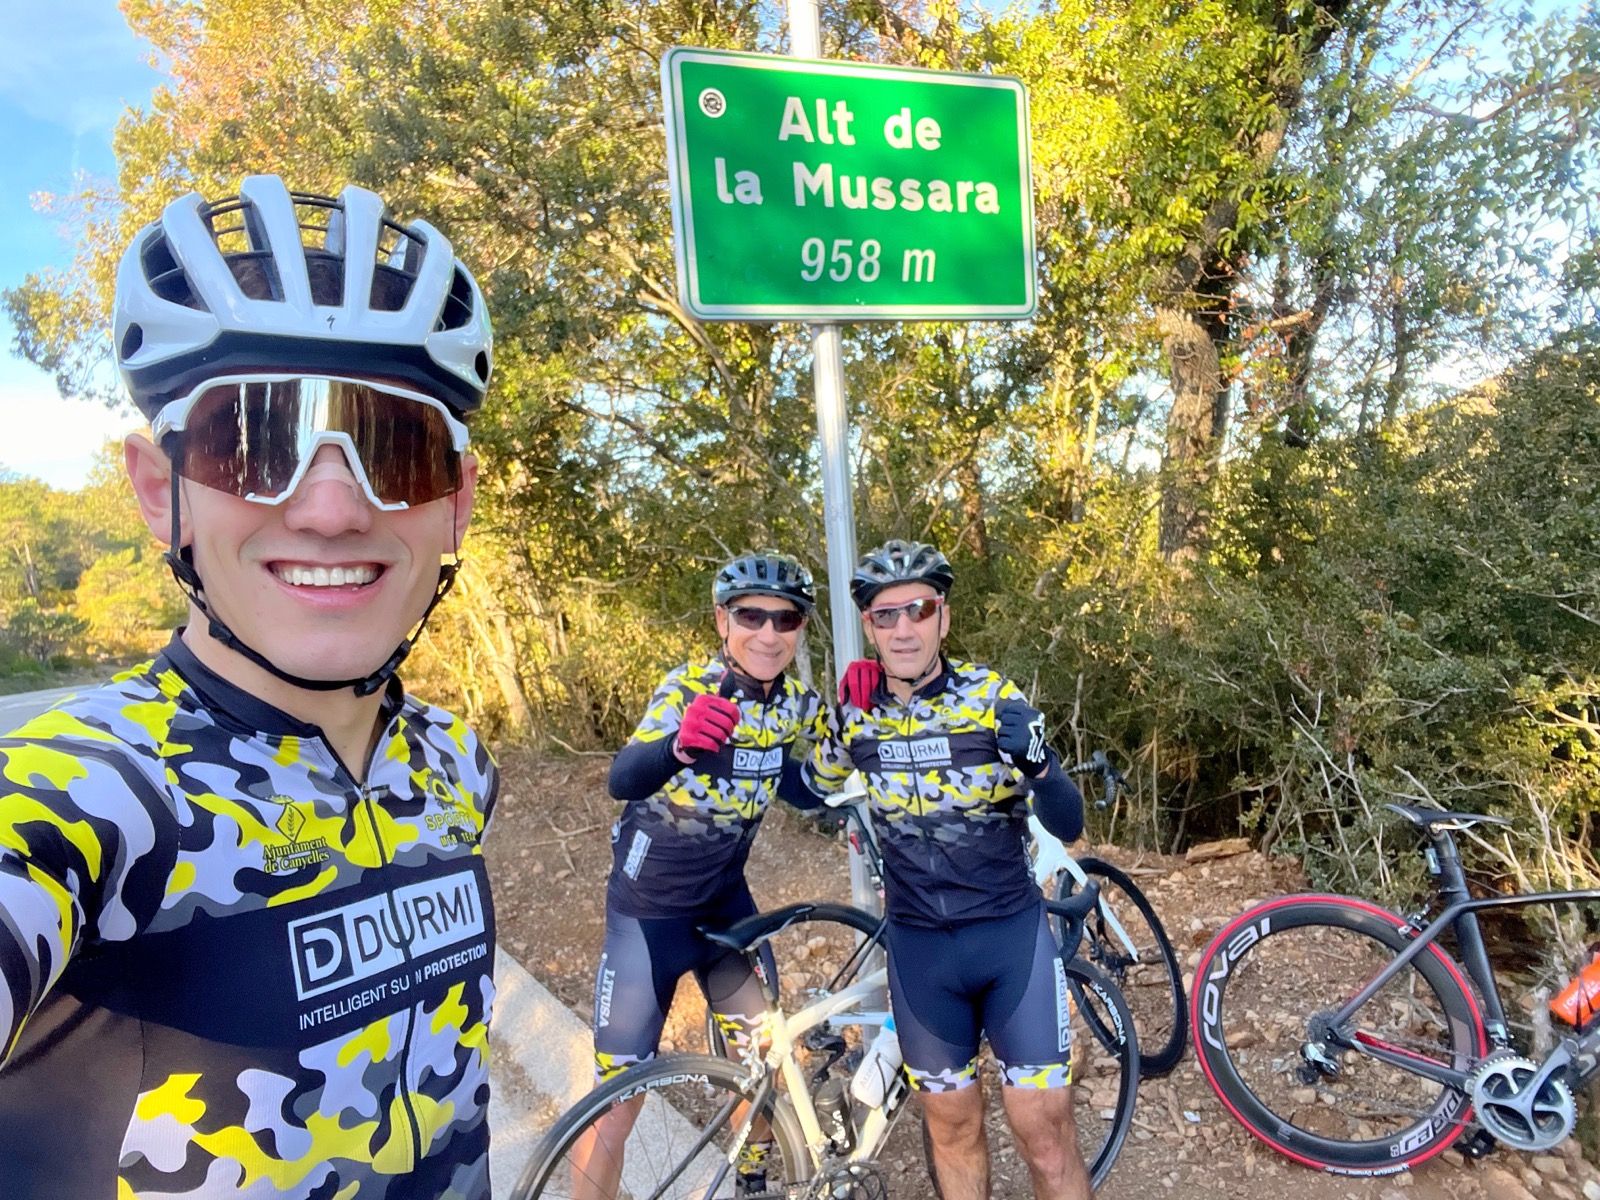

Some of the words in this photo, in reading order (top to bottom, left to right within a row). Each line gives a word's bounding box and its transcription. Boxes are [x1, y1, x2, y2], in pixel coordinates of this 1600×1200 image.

[778, 96, 856, 146] Alt
[883, 107, 942, 151] de
[714, 157, 764, 205] la
[792, 161, 1001, 214] Mussara
[800, 237, 882, 283] 958
[901, 247, 936, 283] m
[895, 742, 945, 759] DURMI
[263, 836, 327, 861] Ajuntament
[264, 859, 279, 874] de
[280, 849, 331, 871] Canyelles
[353, 883, 476, 964] DURMI
[300, 983, 388, 1031] INTELLIGENT
[424, 942, 488, 981] PROTECTION
[599, 968, 616, 1028] LITUSA
[1203, 917, 1270, 1051] roval
[1092, 983, 1127, 1046] KARBONA
[619, 1074, 710, 1103] KARBONA
